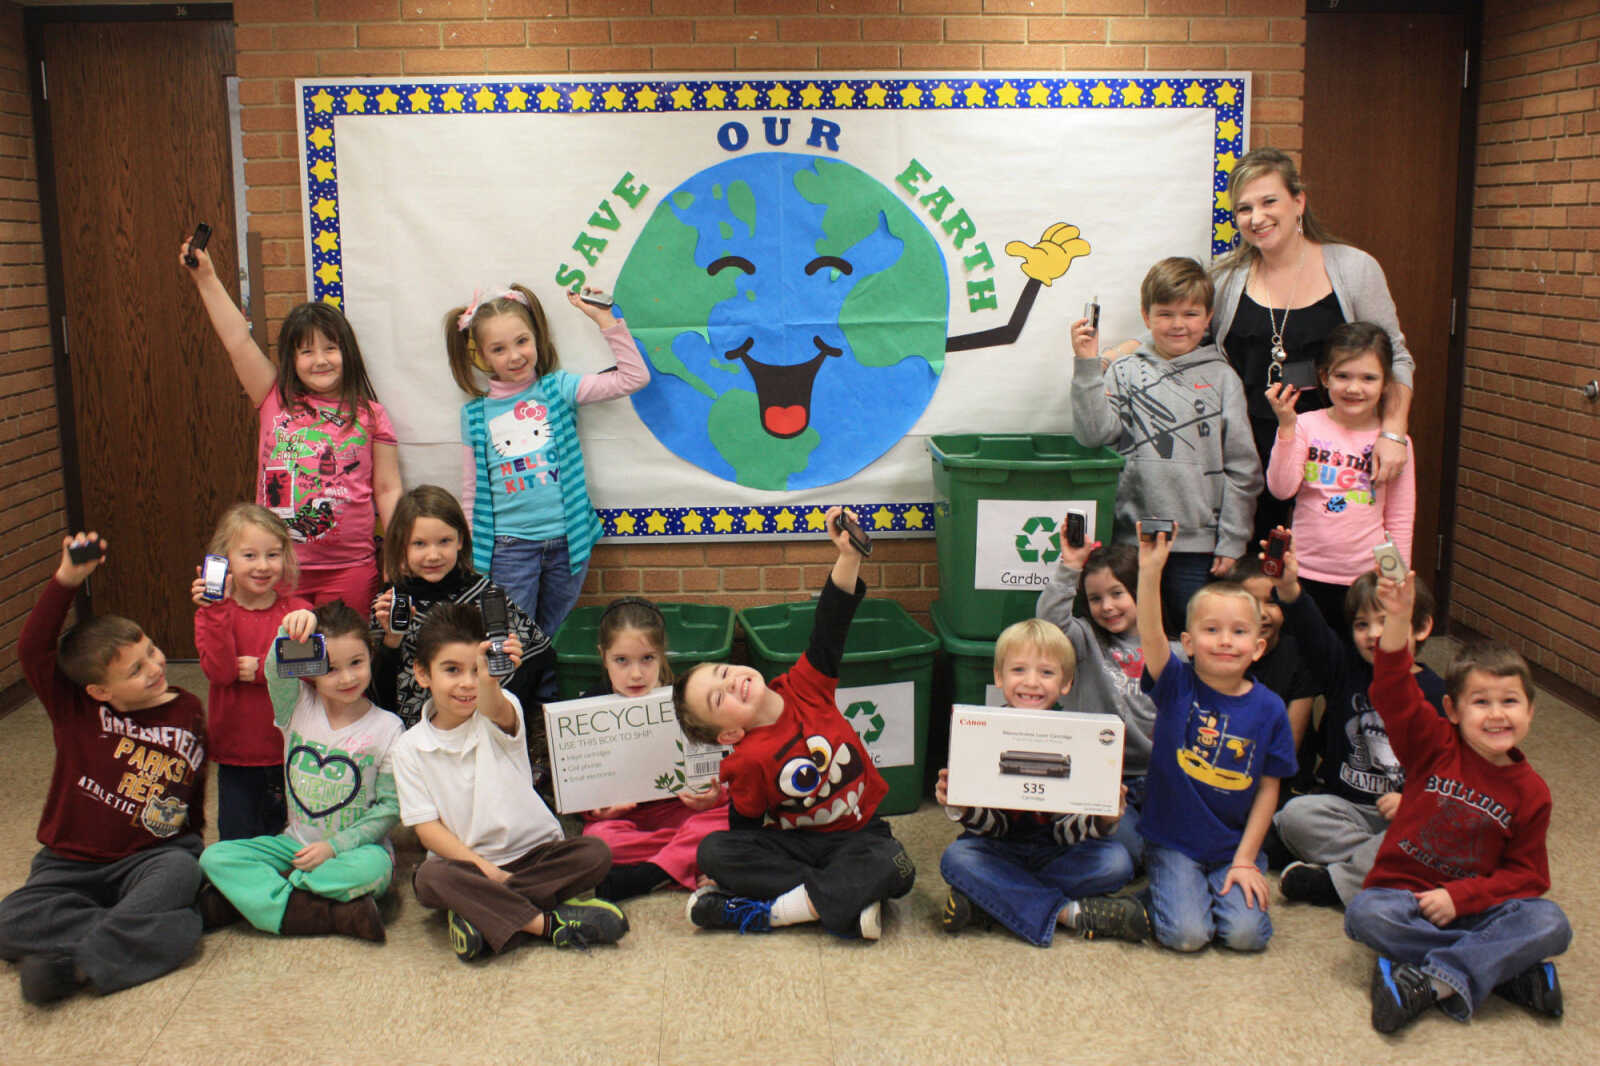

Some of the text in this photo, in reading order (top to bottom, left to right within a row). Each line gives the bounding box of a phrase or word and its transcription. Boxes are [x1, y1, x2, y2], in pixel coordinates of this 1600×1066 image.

[555, 117, 999, 313] SAVE OUR EARTH
[500, 449, 558, 477] HELLO
[1304, 461, 1369, 490] BUGS
[504, 467, 559, 494] KITTY
[1001, 572, 1050, 585] Cardbo
[558, 701, 674, 738] RECYCLE
[959, 718, 987, 727] Canon
[99, 706, 204, 771] GREENFIELD
[559, 742, 576, 751] USE
[577, 738, 598, 747] THIS
[599, 736, 617, 745] BOX
[619, 733, 632, 741] TO
[113, 737, 186, 782] PARKS
[78, 776, 136, 815] ATHLETIC
[117, 772, 164, 803] REC
[1023, 783, 1046, 795] S35
